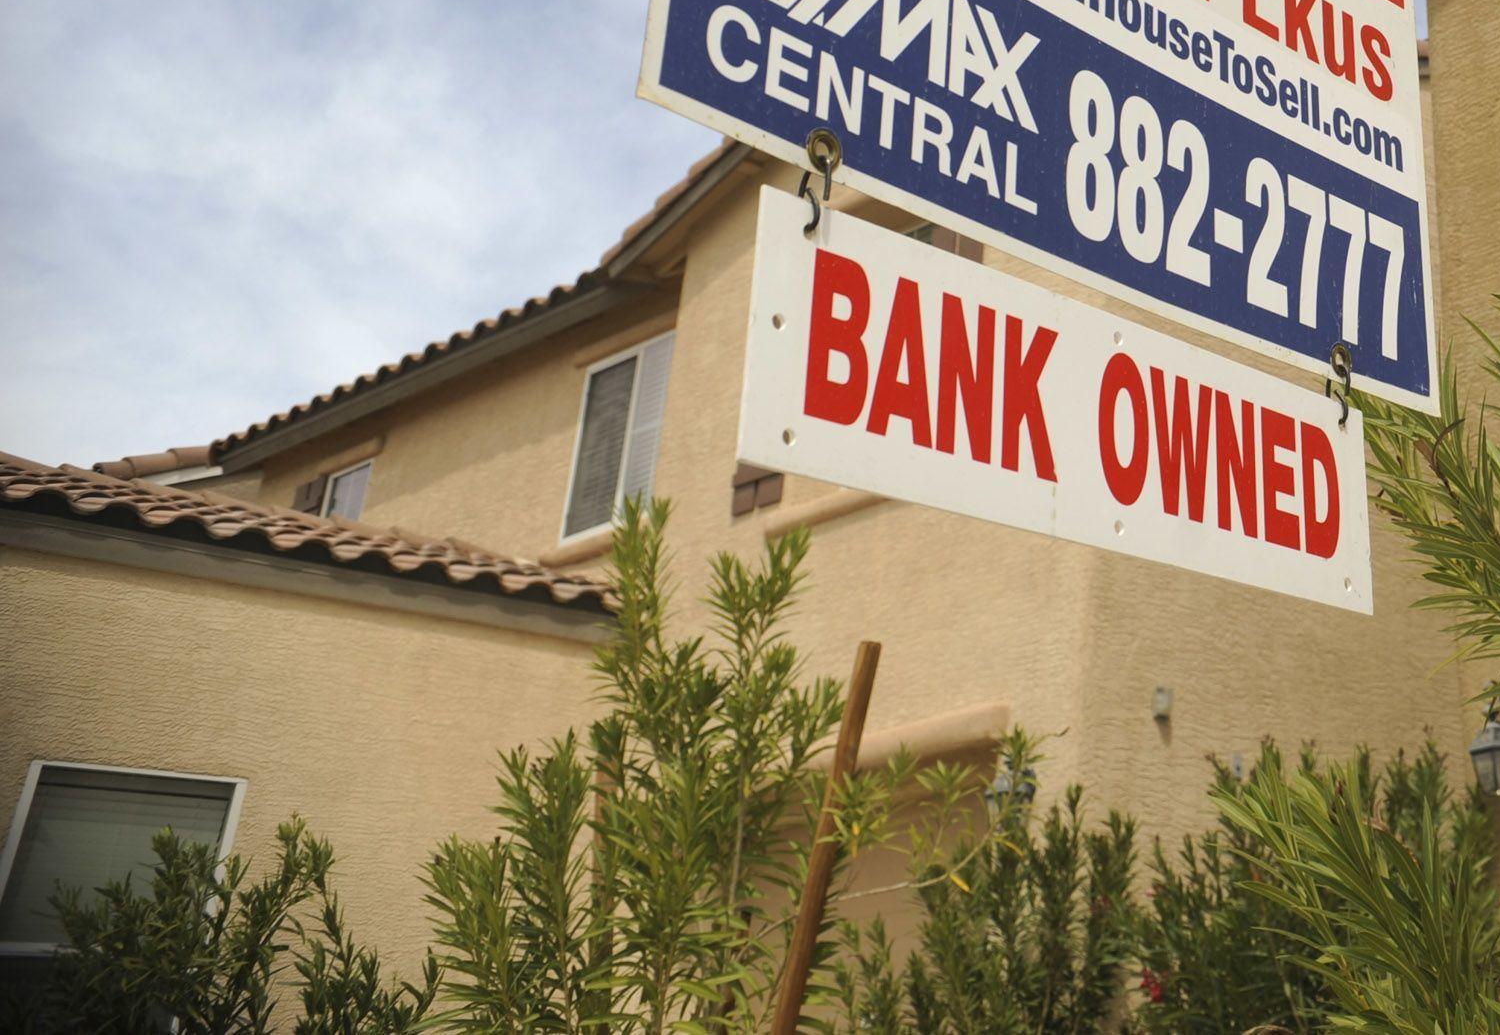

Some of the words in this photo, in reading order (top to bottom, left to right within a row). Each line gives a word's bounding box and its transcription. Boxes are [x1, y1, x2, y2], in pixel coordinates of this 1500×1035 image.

[706, 4, 1038, 216] CENTRAL
[1066, 70, 1405, 362] 882-2777
[803, 249, 1059, 483] BANK
[1098, 352, 1341, 560] OWNED
